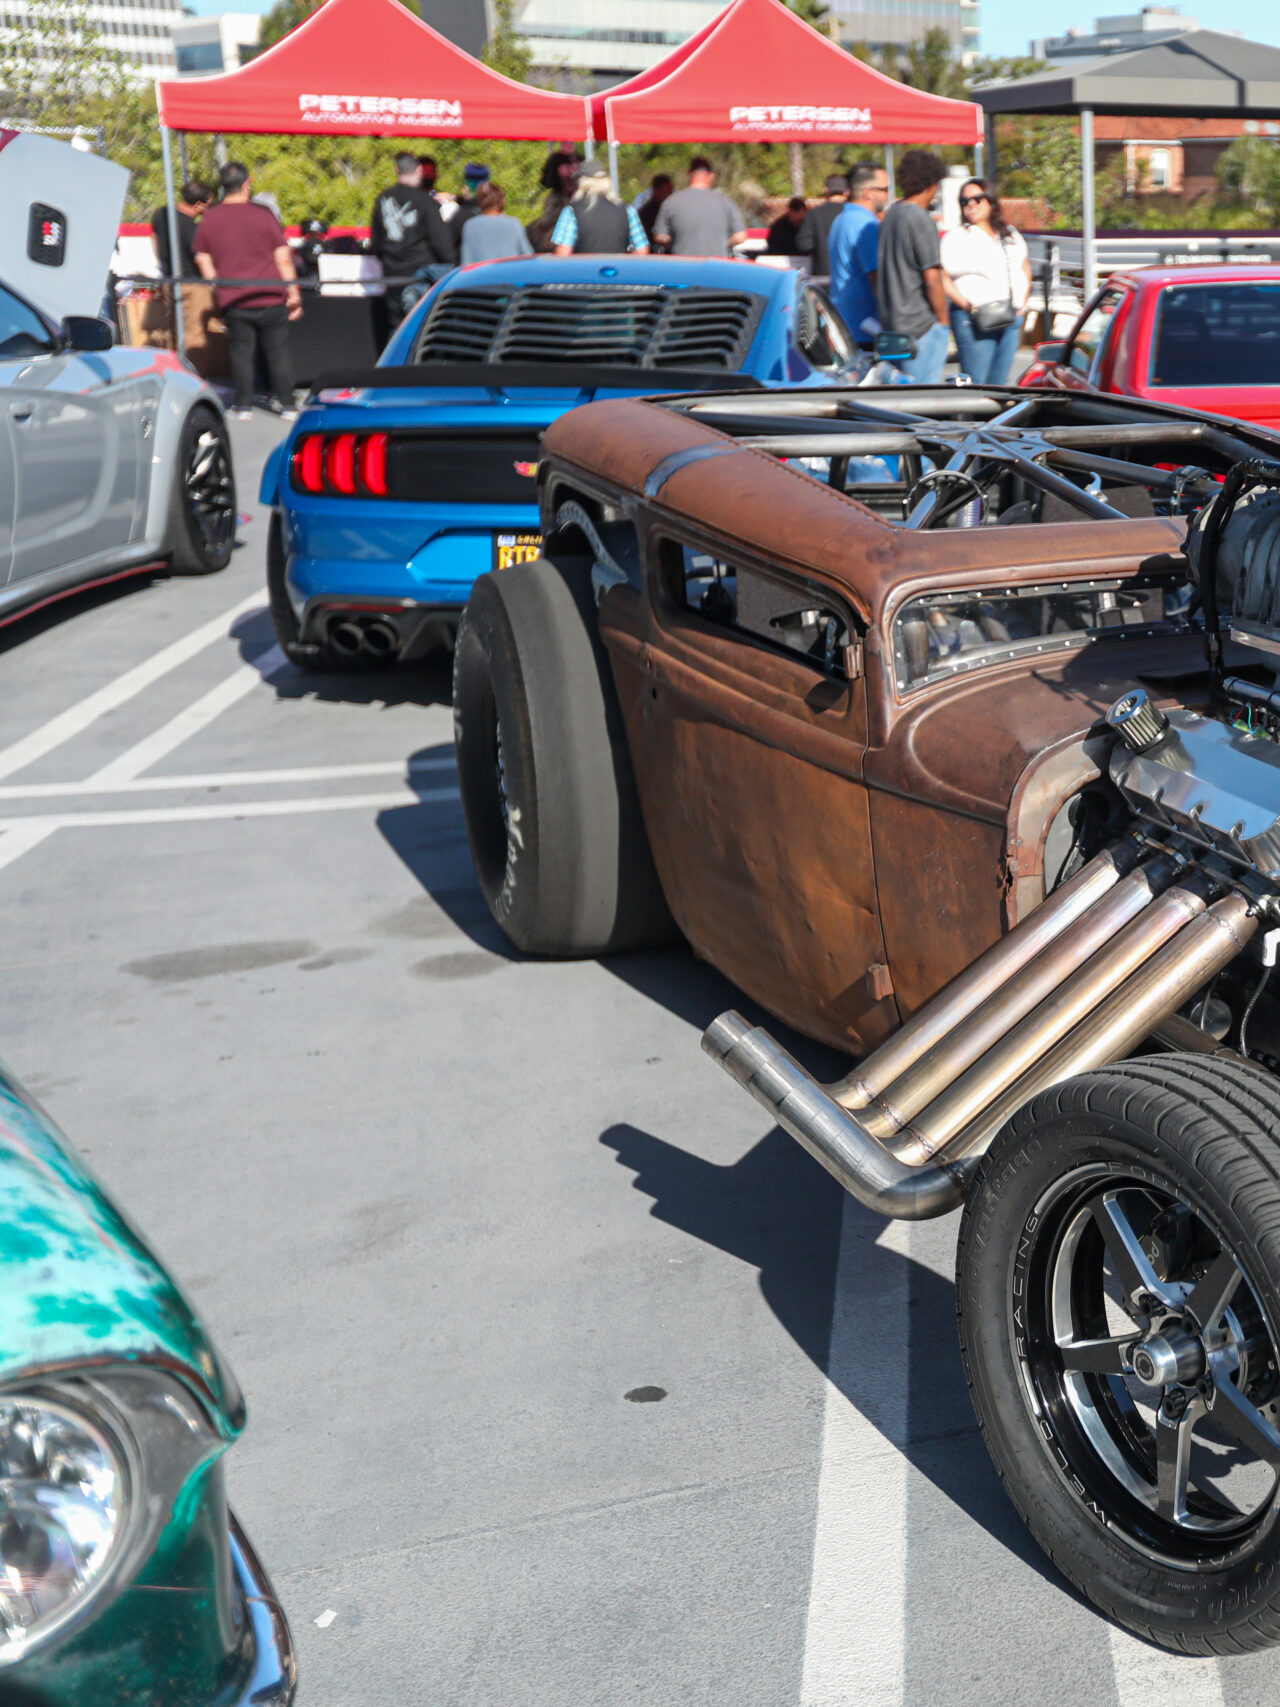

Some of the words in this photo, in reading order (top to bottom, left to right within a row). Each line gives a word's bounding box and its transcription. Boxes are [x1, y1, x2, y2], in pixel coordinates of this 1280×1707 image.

[299, 94, 462, 116] PETERSEN
[730, 106, 871, 122] PETERSEN
[301, 111, 396, 125] AUTOMOTIVE
[398, 114, 463, 127] MUSEUM
[732, 122, 814, 132] AUTOMOTIVE
[816, 122, 873, 132] MUSEUM
[1012, 1212, 1039, 1358] RACING
[1039, 1419, 1105, 1525] WELD
